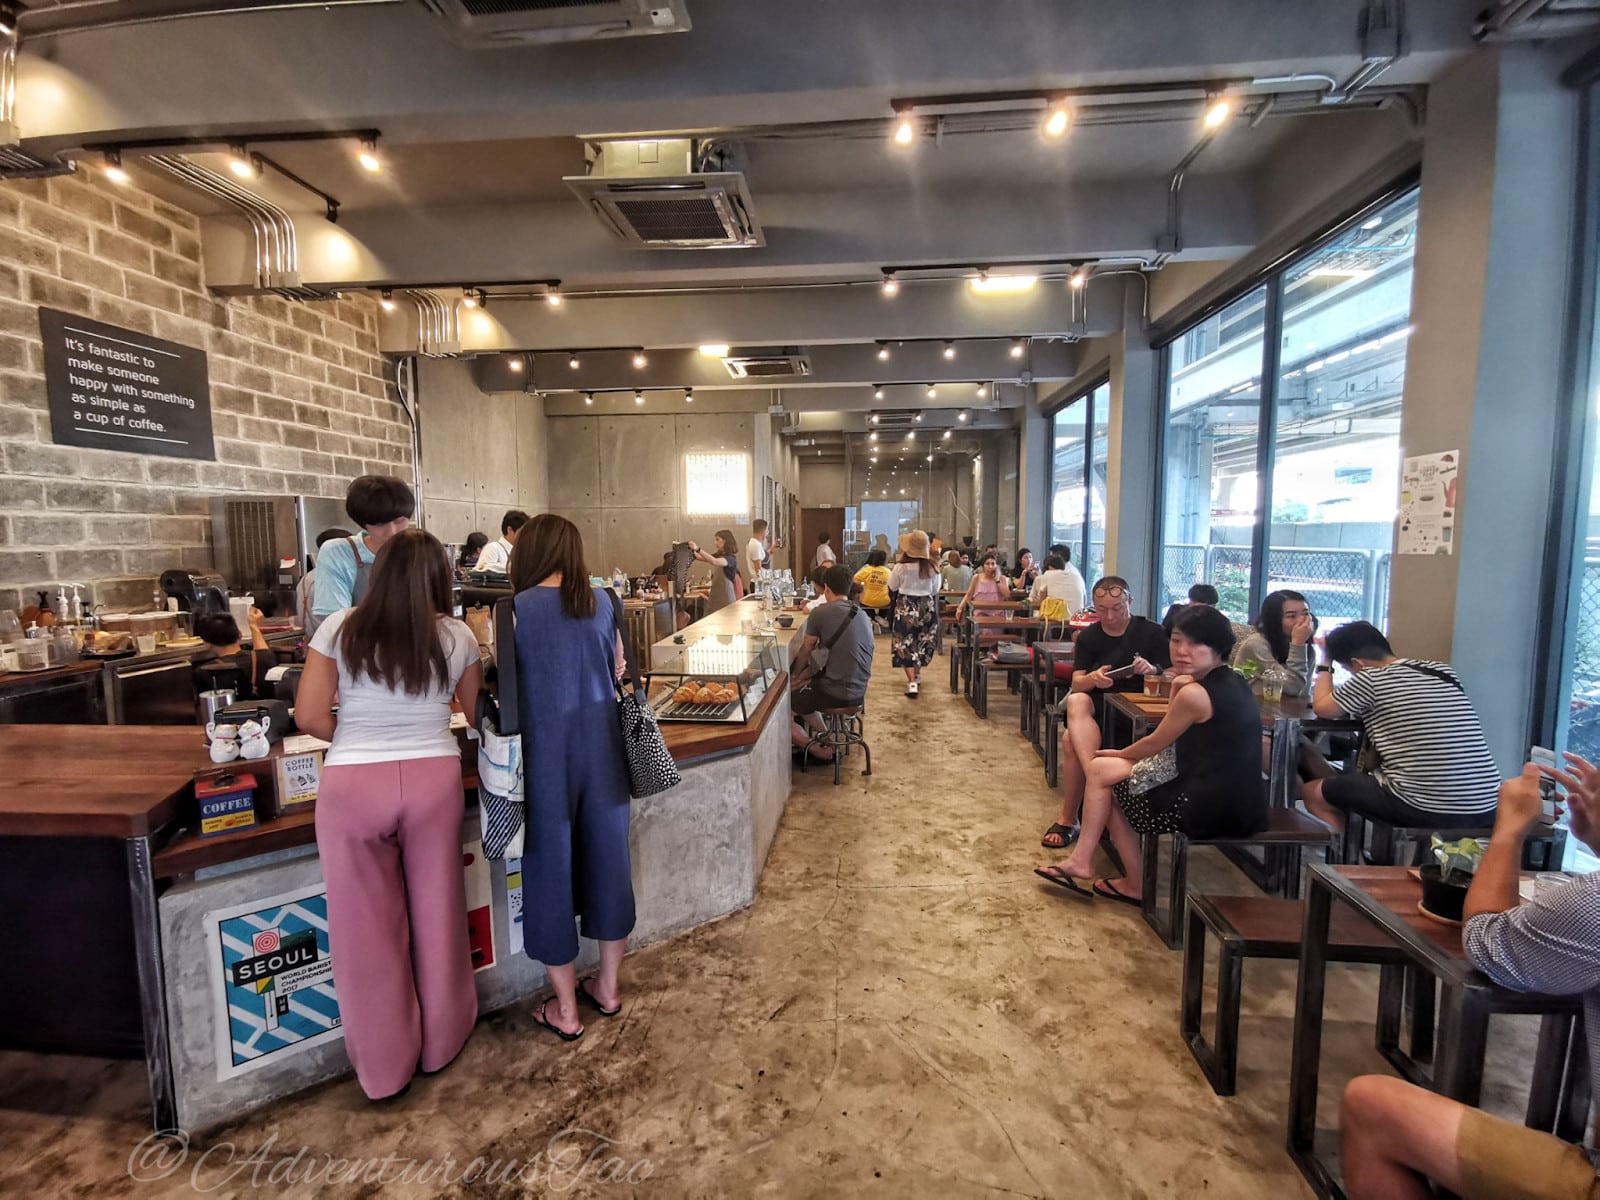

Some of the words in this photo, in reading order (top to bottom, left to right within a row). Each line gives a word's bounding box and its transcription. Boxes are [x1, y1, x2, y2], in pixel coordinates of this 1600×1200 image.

[65, 337, 84, 352] It's
[88, 342, 140, 365] fantastic
[143, 356, 155, 368] to
[67, 357, 103, 373] make
[107, 367, 160, 385] someone
[69, 373, 108, 392] happy
[112, 383, 138, 397] with
[141, 390, 195, 409] something
[71, 392, 86, 403] as
[90, 395, 130, 411] simple
[133, 403, 147, 413] as
[73, 410, 81, 420] a
[86, 413, 108, 425] cup
[112, 415, 126, 426] of
[129, 418, 167, 432] coffee.
[285, 756, 314, 767] COFFEE
[287, 763, 313, 771] BOTTLE
[202, 796, 251, 815] COFFEE
[239, 947, 313, 980] SEOUL
[281, 968, 307, 980] WORLD
[307, 960, 332, 973] BARIST
[282, 984, 298, 994] 2017
